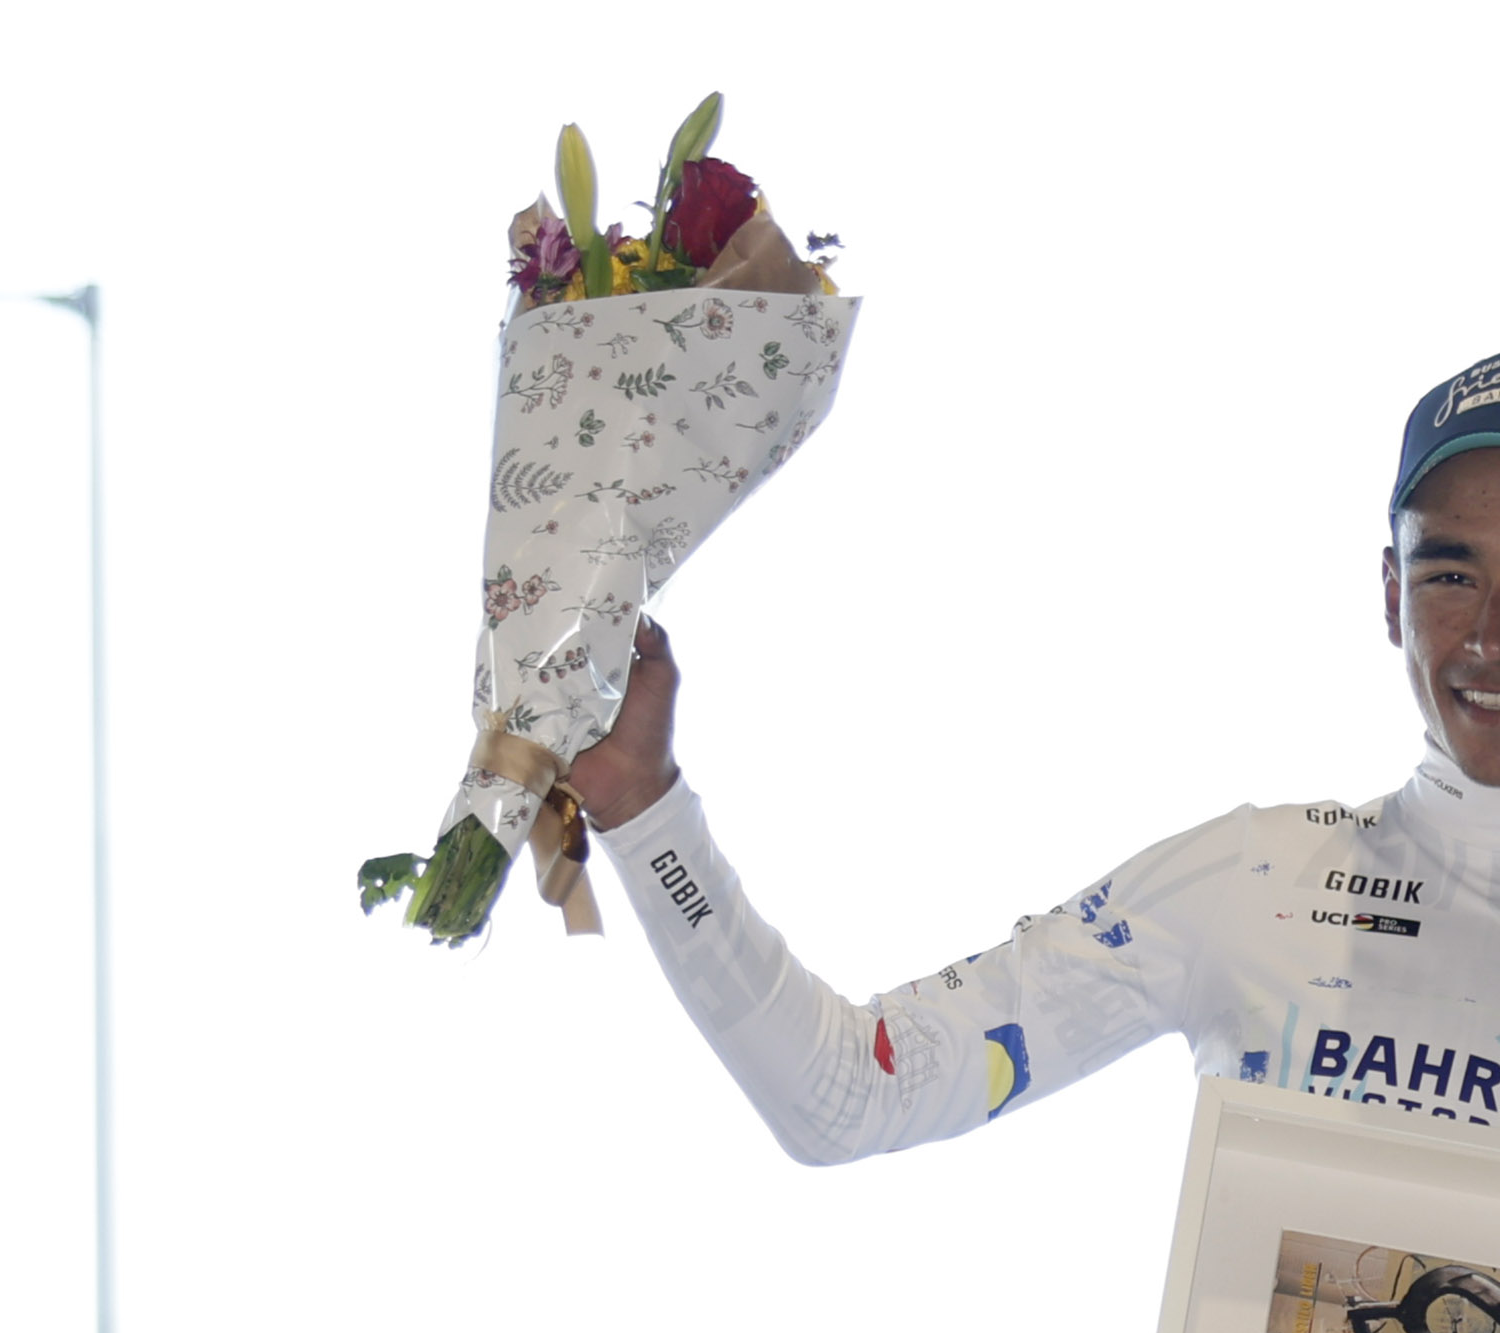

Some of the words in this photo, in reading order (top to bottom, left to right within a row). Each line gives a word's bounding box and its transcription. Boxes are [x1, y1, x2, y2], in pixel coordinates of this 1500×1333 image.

[649, 848, 714, 930] GOBIK
[1324, 869, 1424, 904] GOBIK
[1311, 909, 1349, 927] UCI
